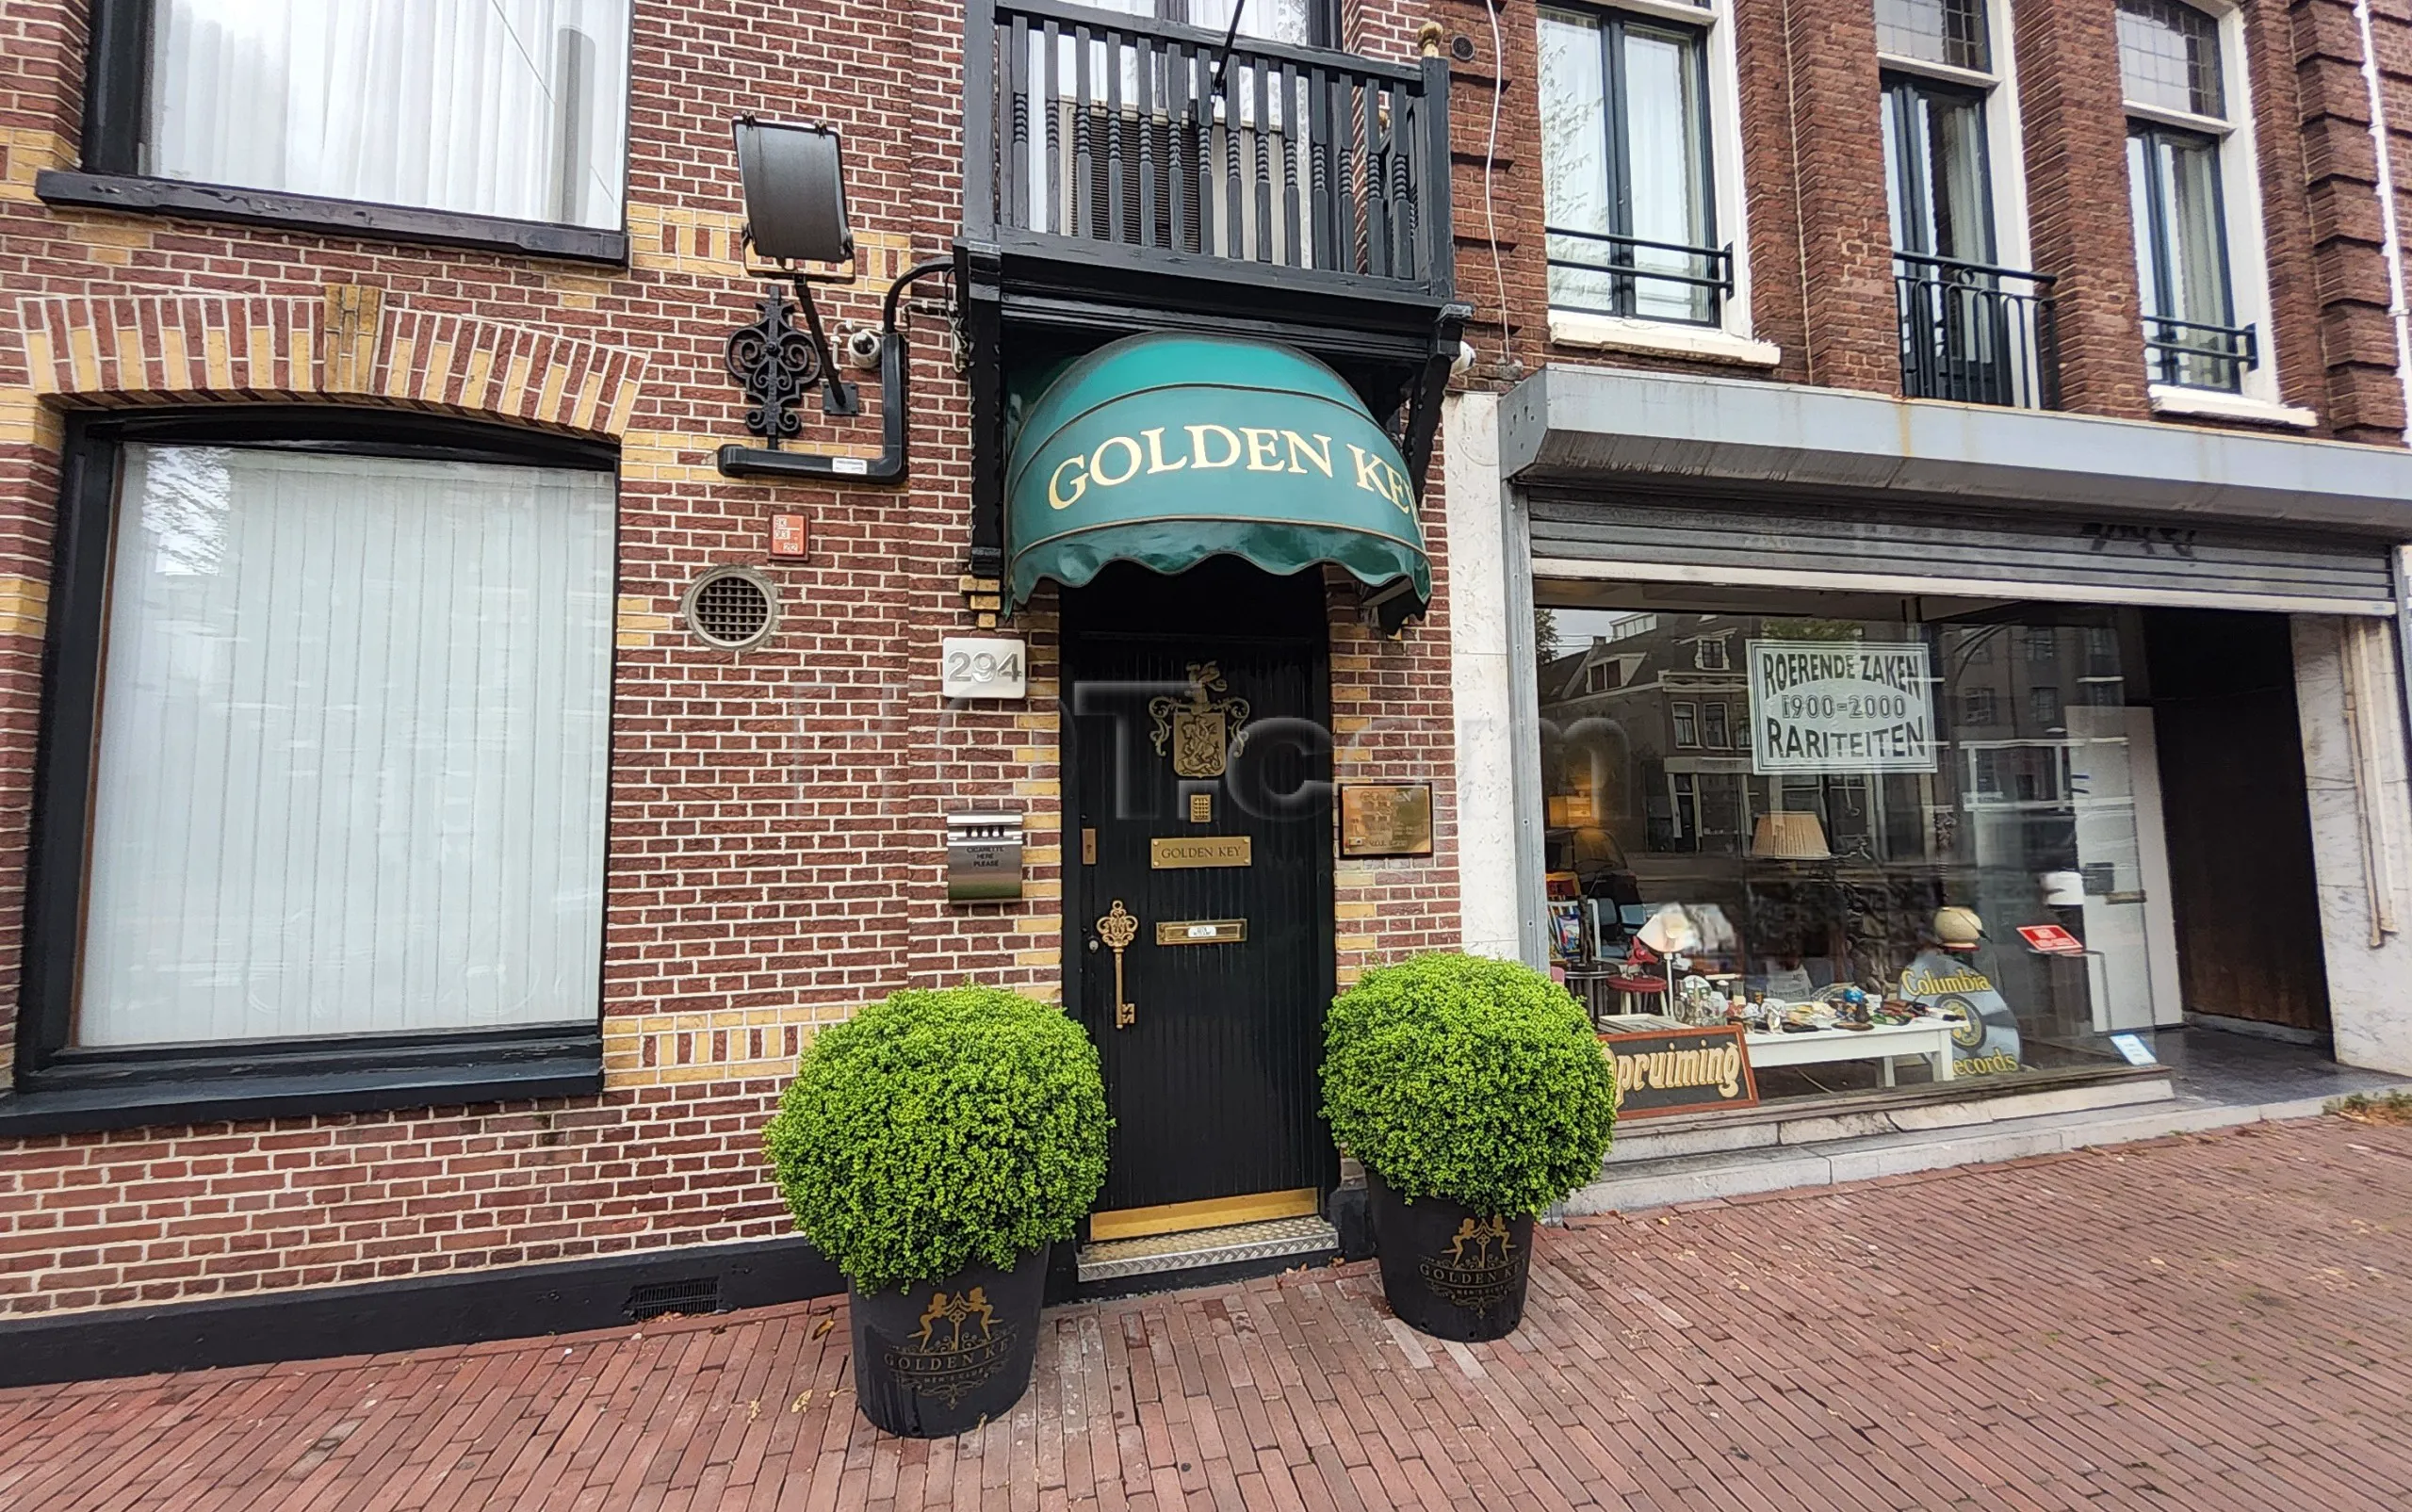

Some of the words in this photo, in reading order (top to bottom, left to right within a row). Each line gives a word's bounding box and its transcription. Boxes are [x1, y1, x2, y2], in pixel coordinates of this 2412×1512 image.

[1048, 423, 1333, 510] GOLDEN
[948, 650, 1021, 683] 294
[1763, 653, 1855, 700] ROERENDE
[1860, 655, 1921, 701] ZAKEN
[1782, 694, 1906, 719] 1900-2000
[1767, 715, 1925, 758] RARITEITEN
[1161, 847, 1214, 859] GOLDEN
[1218, 846, 1241, 857] KEY
[1901, 967, 1993, 996] Columbia
[1953, 1046, 2019, 1076] ecords
[1419, 1262, 1497, 1285] GOLDEN
[884, 1352, 974, 1371] GOLDEN
